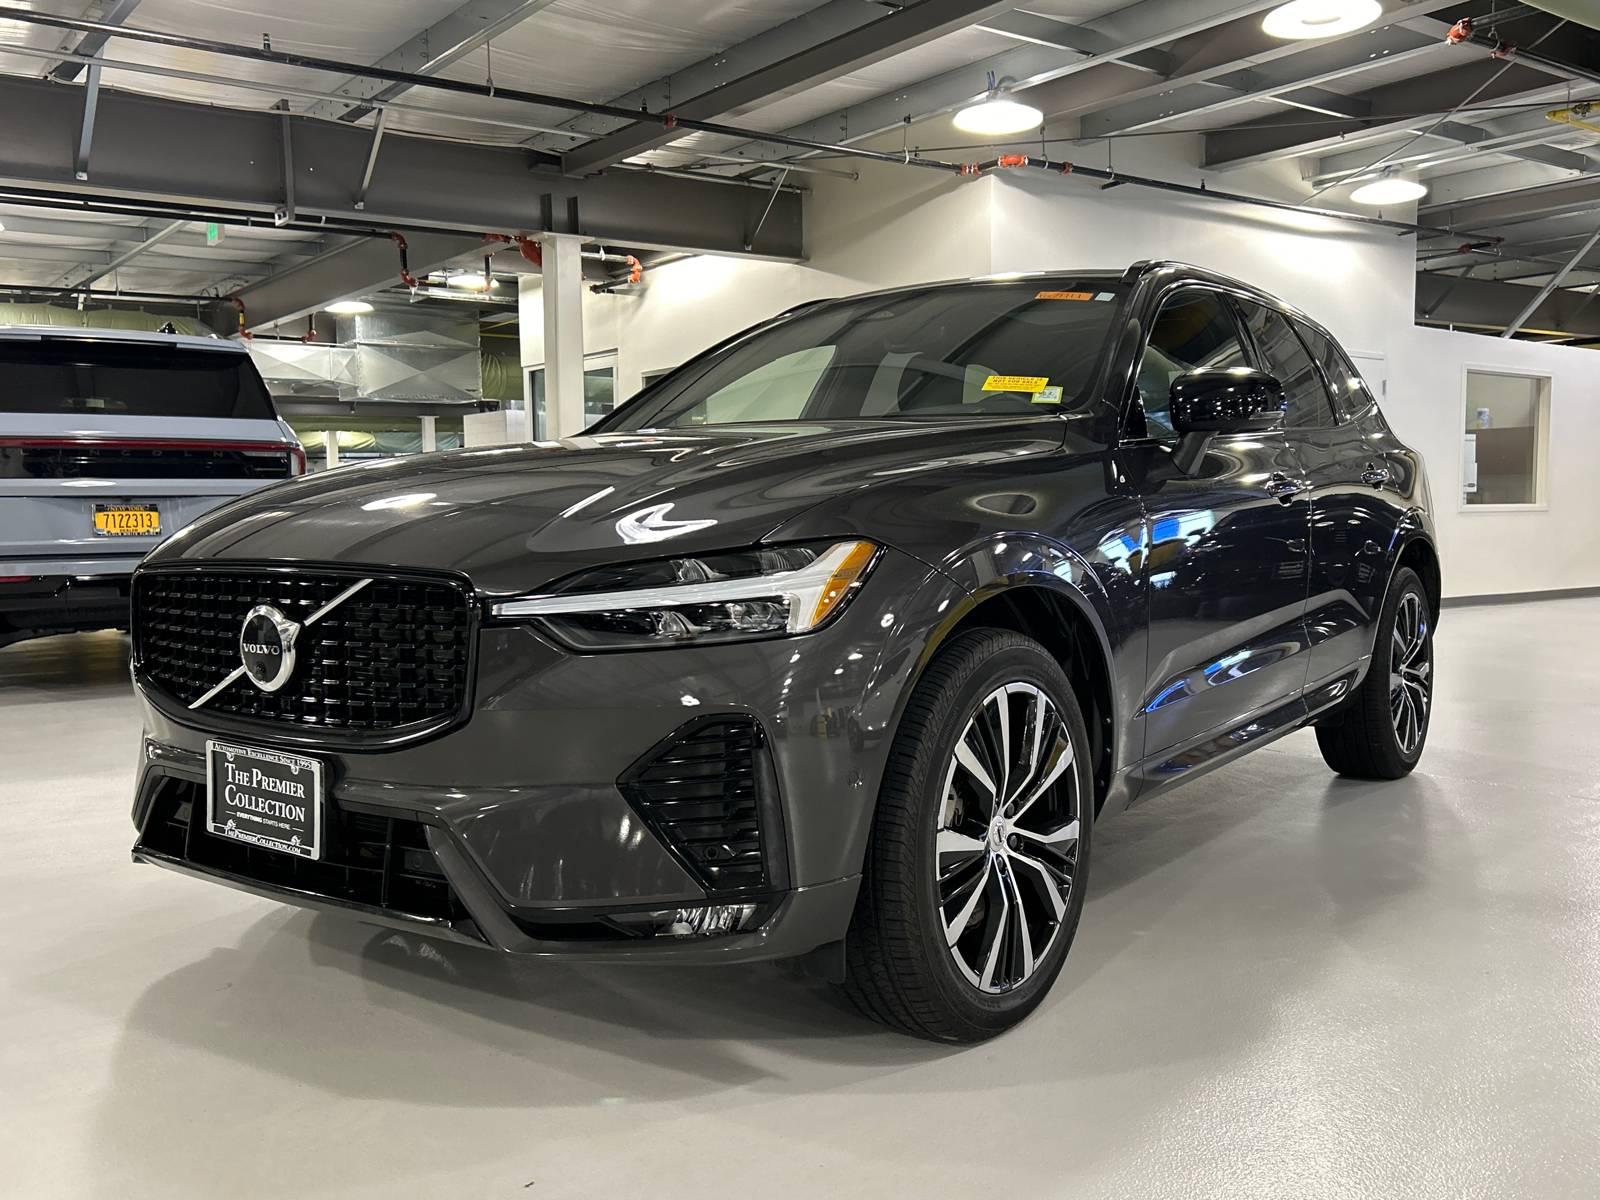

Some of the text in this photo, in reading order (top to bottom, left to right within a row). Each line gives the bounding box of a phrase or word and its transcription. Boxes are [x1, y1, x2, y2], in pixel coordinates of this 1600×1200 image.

[20, 448, 223, 457] LINCOLN
[103, 513, 152, 528] 7122313
[242, 643, 280, 655] VOLVO
[296, 760, 312, 769] 1995
[224, 762, 305, 798] THE PREMIER
[225, 784, 305, 822] COLLECTION
[236, 811, 262, 823] EVERYTHING
[262, 818, 278, 828] STARTS
